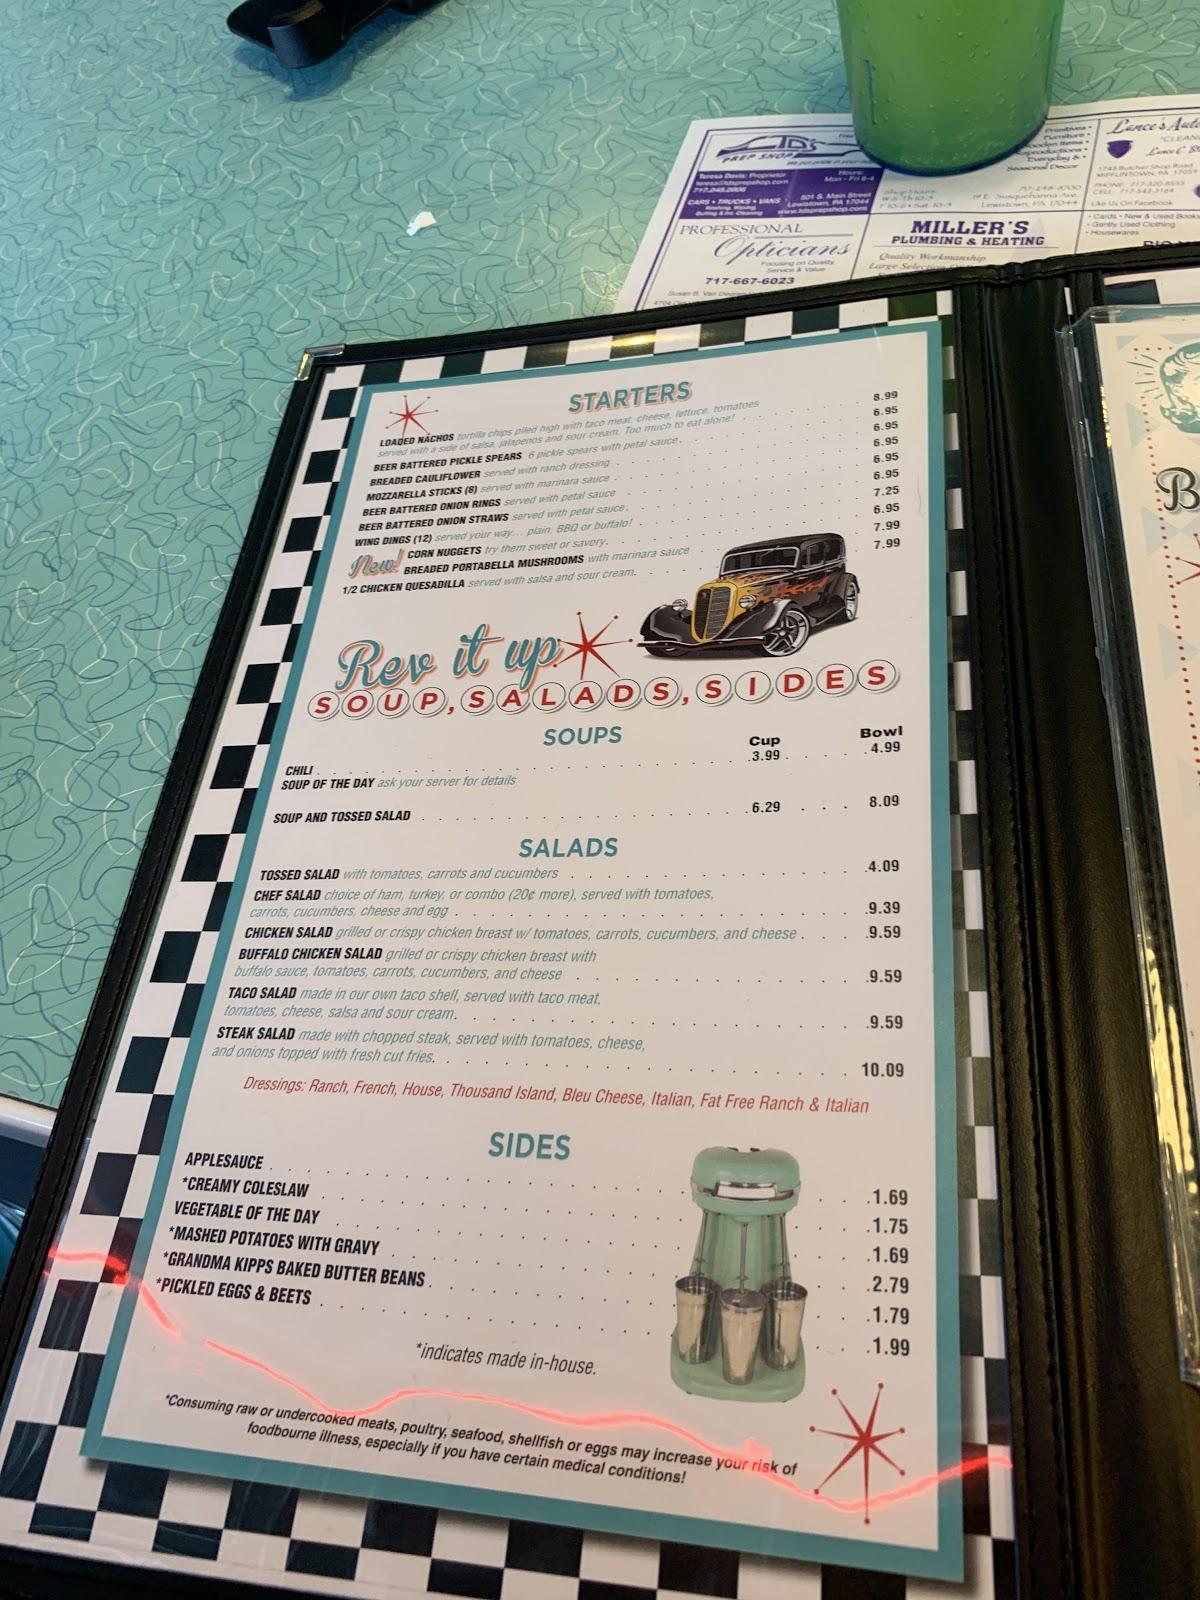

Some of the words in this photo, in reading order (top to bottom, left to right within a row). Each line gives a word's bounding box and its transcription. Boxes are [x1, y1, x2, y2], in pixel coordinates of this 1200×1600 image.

[1106, 119, 1166, 134] Lance's
[722, 154, 756, 163] PREP
[758, 152, 792, 161] SHOP
[680, 223, 802, 235] PROFESSIONAL
[911, 220, 1029, 235] MILLER'S
[892, 236, 962, 245] PLUMBING
[967, 237, 976, 245] &
[982, 236, 1045, 246] HEATING
[714, 236, 850, 265] Opticians
[880, 253, 915, 261] Quality
[920, 253, 986, 262] Workmanship
[705, 277, 795, 285] 717-667-6023
[568, 381, 694, 414] STARTERS
[874, 390, 898, 402] 8.99
[874, 406, 898, 417] 6.95
[374, 462, 397, 471] BEER
[400, 458, 446, 469] BATTERED
[450, 455, 482, 467] PICKLE
[485, 452, 522, 463] SPEARS
[370, 476, 412, 486] BREADED
[415, 471, 481, 483] CAULIFLOWER
[366, 489, 426, 501] MOZZARELLA
[429, 487, 462, 497] STICKS
[465, 485, 477, 496] (8)
[874, 486, 900, 497] 7.25
[874, 538, 900, 550] 7.99
[349, 549, 404, 578] New!
[343, 585, 357, 594] 1/2
[360, 582, 402, 593] CHICKEN
[405, 579, 465, 591] QUESADILLA
[335, 640, 438, 692] Rev
[452, 624, 504, 680] it
[504, 636, 562, 692] up
[698, 661, 894, 703] SIDES
[543, 726, 622, 746] SOUPS
[749, 736, 780, 748] Cup
[860, 726, 903, 739] Bowl
[753, 750, 780, 761] 3.99
[871, 742, 900, 754] 4.99
[285, 766, 313, 776] CHILI
[282, 780, 310, 790] SOUP
[313, 780, 326, 789] OF
[330, 779, 350, 789] THE
[353, 778, 374, 788] DAY
[378, 777, 397, 788] ask
[399, 777, 424, 790] your
[426, 776, 460, 788] server
[463, 776, 478, 786] for
[481, 775, 516, 786] details
[752, 801, 780, 813] 6.29
[869, 795, 899, 808] 8.09
[274, 813, 302, 824] SOUP
[305, 812, 328, 822] AND
[331, 812, 372, 822] TOSSED
[375, 810, 410, 821] SALAD
[519, 838, 618, 858] SALADS
[868, 860, 899, 873] 4.09
[261, 870, 301, 881] TOSSED
[304, 869, 339, 880] SALAD
[254, 890, 283, 901] CHEF
[285, 890, 321, 901] SALAD
[869, 902, 900, 915] 9.39
[245, 927, 293, 938] CHICKEN
[296, 927, 332, 938] SALAD
[869, 926, 901, 939] 9.59
[239, 948, 288, 960] BUFFALO
[292, 948, 341, 960] CHICKEN
[344, 948, 382, 959] SALAD
[869, 970, 902, 983] 9.59
[870, 1016, 903, 1029] 9.59
[217, 1027, 254, 1039] STEAK
[257, 1027, 295, 1040] SALAD
[861, 1063, 904, 1078] 10.09
[243, 1077, 307, 1091] Dressings:
[309, 1079, 349, 1094] Ranch,
[354, 1080, 397, 1096] French,
[402, 1082, 444, 1098] House,
[449, 1083, 511, 1099] Thousand
[515, 1085, 556, 1102] Island,
[562, 1087, 592, 1102] Bleu
[595, 1089, 645, 1106] Cheese,
[651, 1091, 695, 1108] Italian,
[700, 1093, 722, 1108] Fat
[725, 1094, 755, 1110] Free
[759, 1095, 802, 1112] Ranch
[809, 1098, 819, 1112] &
[826, 1098, 869, 1114] Italian
[488, 1132, 570, 1161] SIDES
[185, 1152, 264, 1170] APPLESAUCE
[243, 1181, 309, 1197] COLESLAW
[874, 1189, 908, 1206] 1.69
[174, 1201, 244, 1220] VEGETABLE
[246, 1206, 263, 1220] OF
[266, 1207, 290, 1222] THE
[293, 1209, 320, 1224] DAY
[874, 1219, 908, 1235] 1.75
[229, 1231, 294, 1249] POTATOES
[298, 1236, 332, 1252] WITH
[334, 1238, 380, 1256] GRAVY
[874, 1248, 909, 1265] 1.69
[234, 1256, 274, 1274] KIPPS
[276, 1260, 321, 1278] BAKED
[324, 1264, 377, 1284] BUTTER
[380, 1268, 425, 1288] BEANS
[217, 1282, 252, 1300] EGGS
[255, 1286, 265, 1300] &
[268, 1287, 312, 1305] BEETS
[872, 1277, 909, 1294] 2.79
[873, 1308, 910, 1326] 1.79
[873, 1339, 910, 1357] 1.99
[486, 1351, 527, 1369] made
[529, 1353, 597, 1376] in-house.
[235, 1404, 258, 1415] raw
[260, 1406, 274, 1417] or
[275, 1406, 356, 1426] undercooked
[358, 1417, 398, 1432] meats,
[400, 1421, 448, 1440] poultry,
[450, 1427, 505, 1446] seafood,
[509, 1432, 564, 1451] shellfish
[567, 1440, 582, 1451] or
[585, 1442, 617, 1457] eggs
[621, 1447, 650, 1462] may
[653, 1448, 712, 1466] increase
[715, 1456, 747, 1473] your
[751, 1460, 778, 1474] risk
[781, 1462, 797, 1476] of
[247, 1422, 316, 1441] foodbourne
[319, 1430, 362, 1448] illness,
[365, 1437, 429, 1457] especially
[431, 1442, 441, 1455] if
[443, 1446, 467, 1459] you
[469, 1449, 501, 1463] have
[503, 1451, 549, 1468] certain
[553, 1458, 605, 1475] medical
[608, 1463, 686, 1484] conditions!
